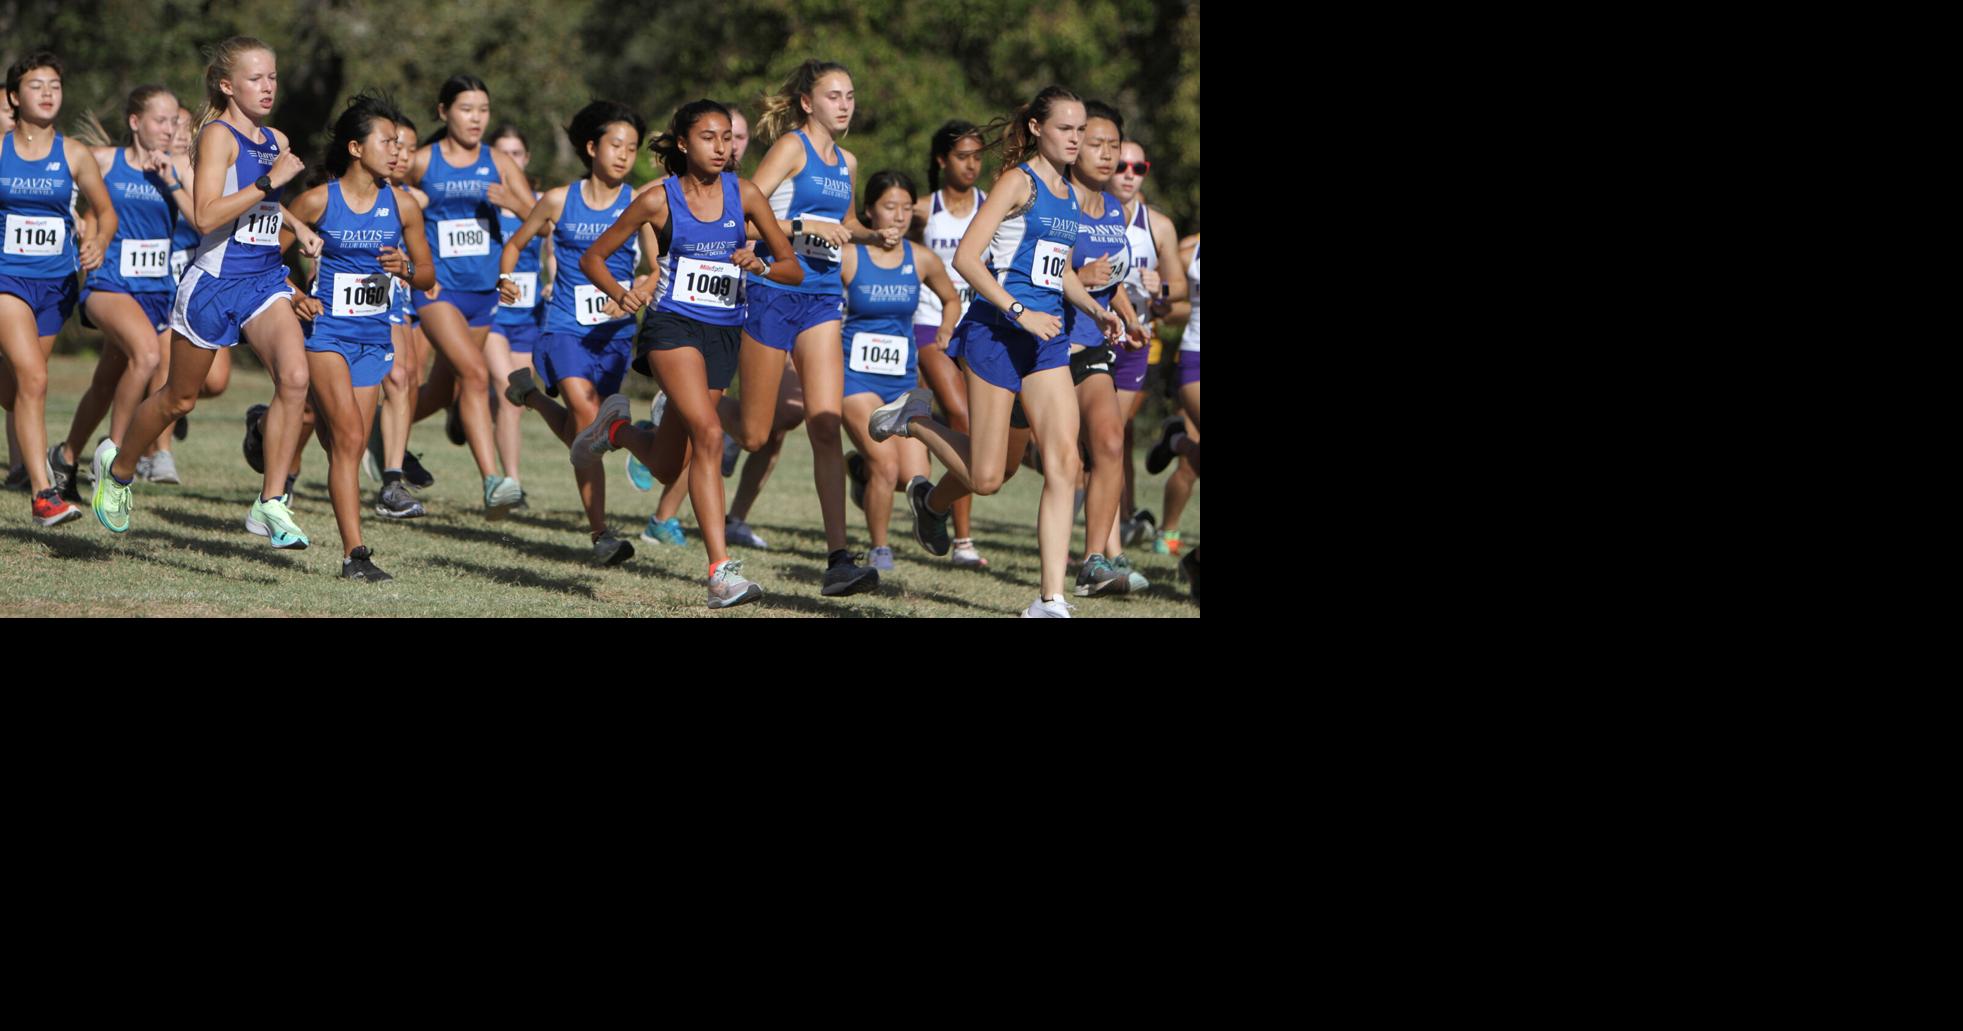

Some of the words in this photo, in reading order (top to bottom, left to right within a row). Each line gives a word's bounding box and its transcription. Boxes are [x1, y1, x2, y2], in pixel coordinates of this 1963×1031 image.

[12, 177, 53, 188] DAVIS
[446, 180, 482, 191] DAVIS
[824, 177, 849, 191] DAVIS
[375, 208, 389, 217] NB
[248, 213, 279, 235] 1113
[1052, 217, 1079, 232] DAVIS
[1088, 224, 1123, 236] DAVIS
[14, 227, 57, 246] 1104
[342, 230, 383, 241] DAVIS
[448, 230, 484, 246] 1080
[696, 241, 727, 252] DAVIS
[130, 250, 166, 267] 1119
[686, 272, 731, 297] 1009
[872, 284, 908, 296] DAVIS
[343, 286, 385, 306] 1060
[861, 345, 900, 365] 1044
